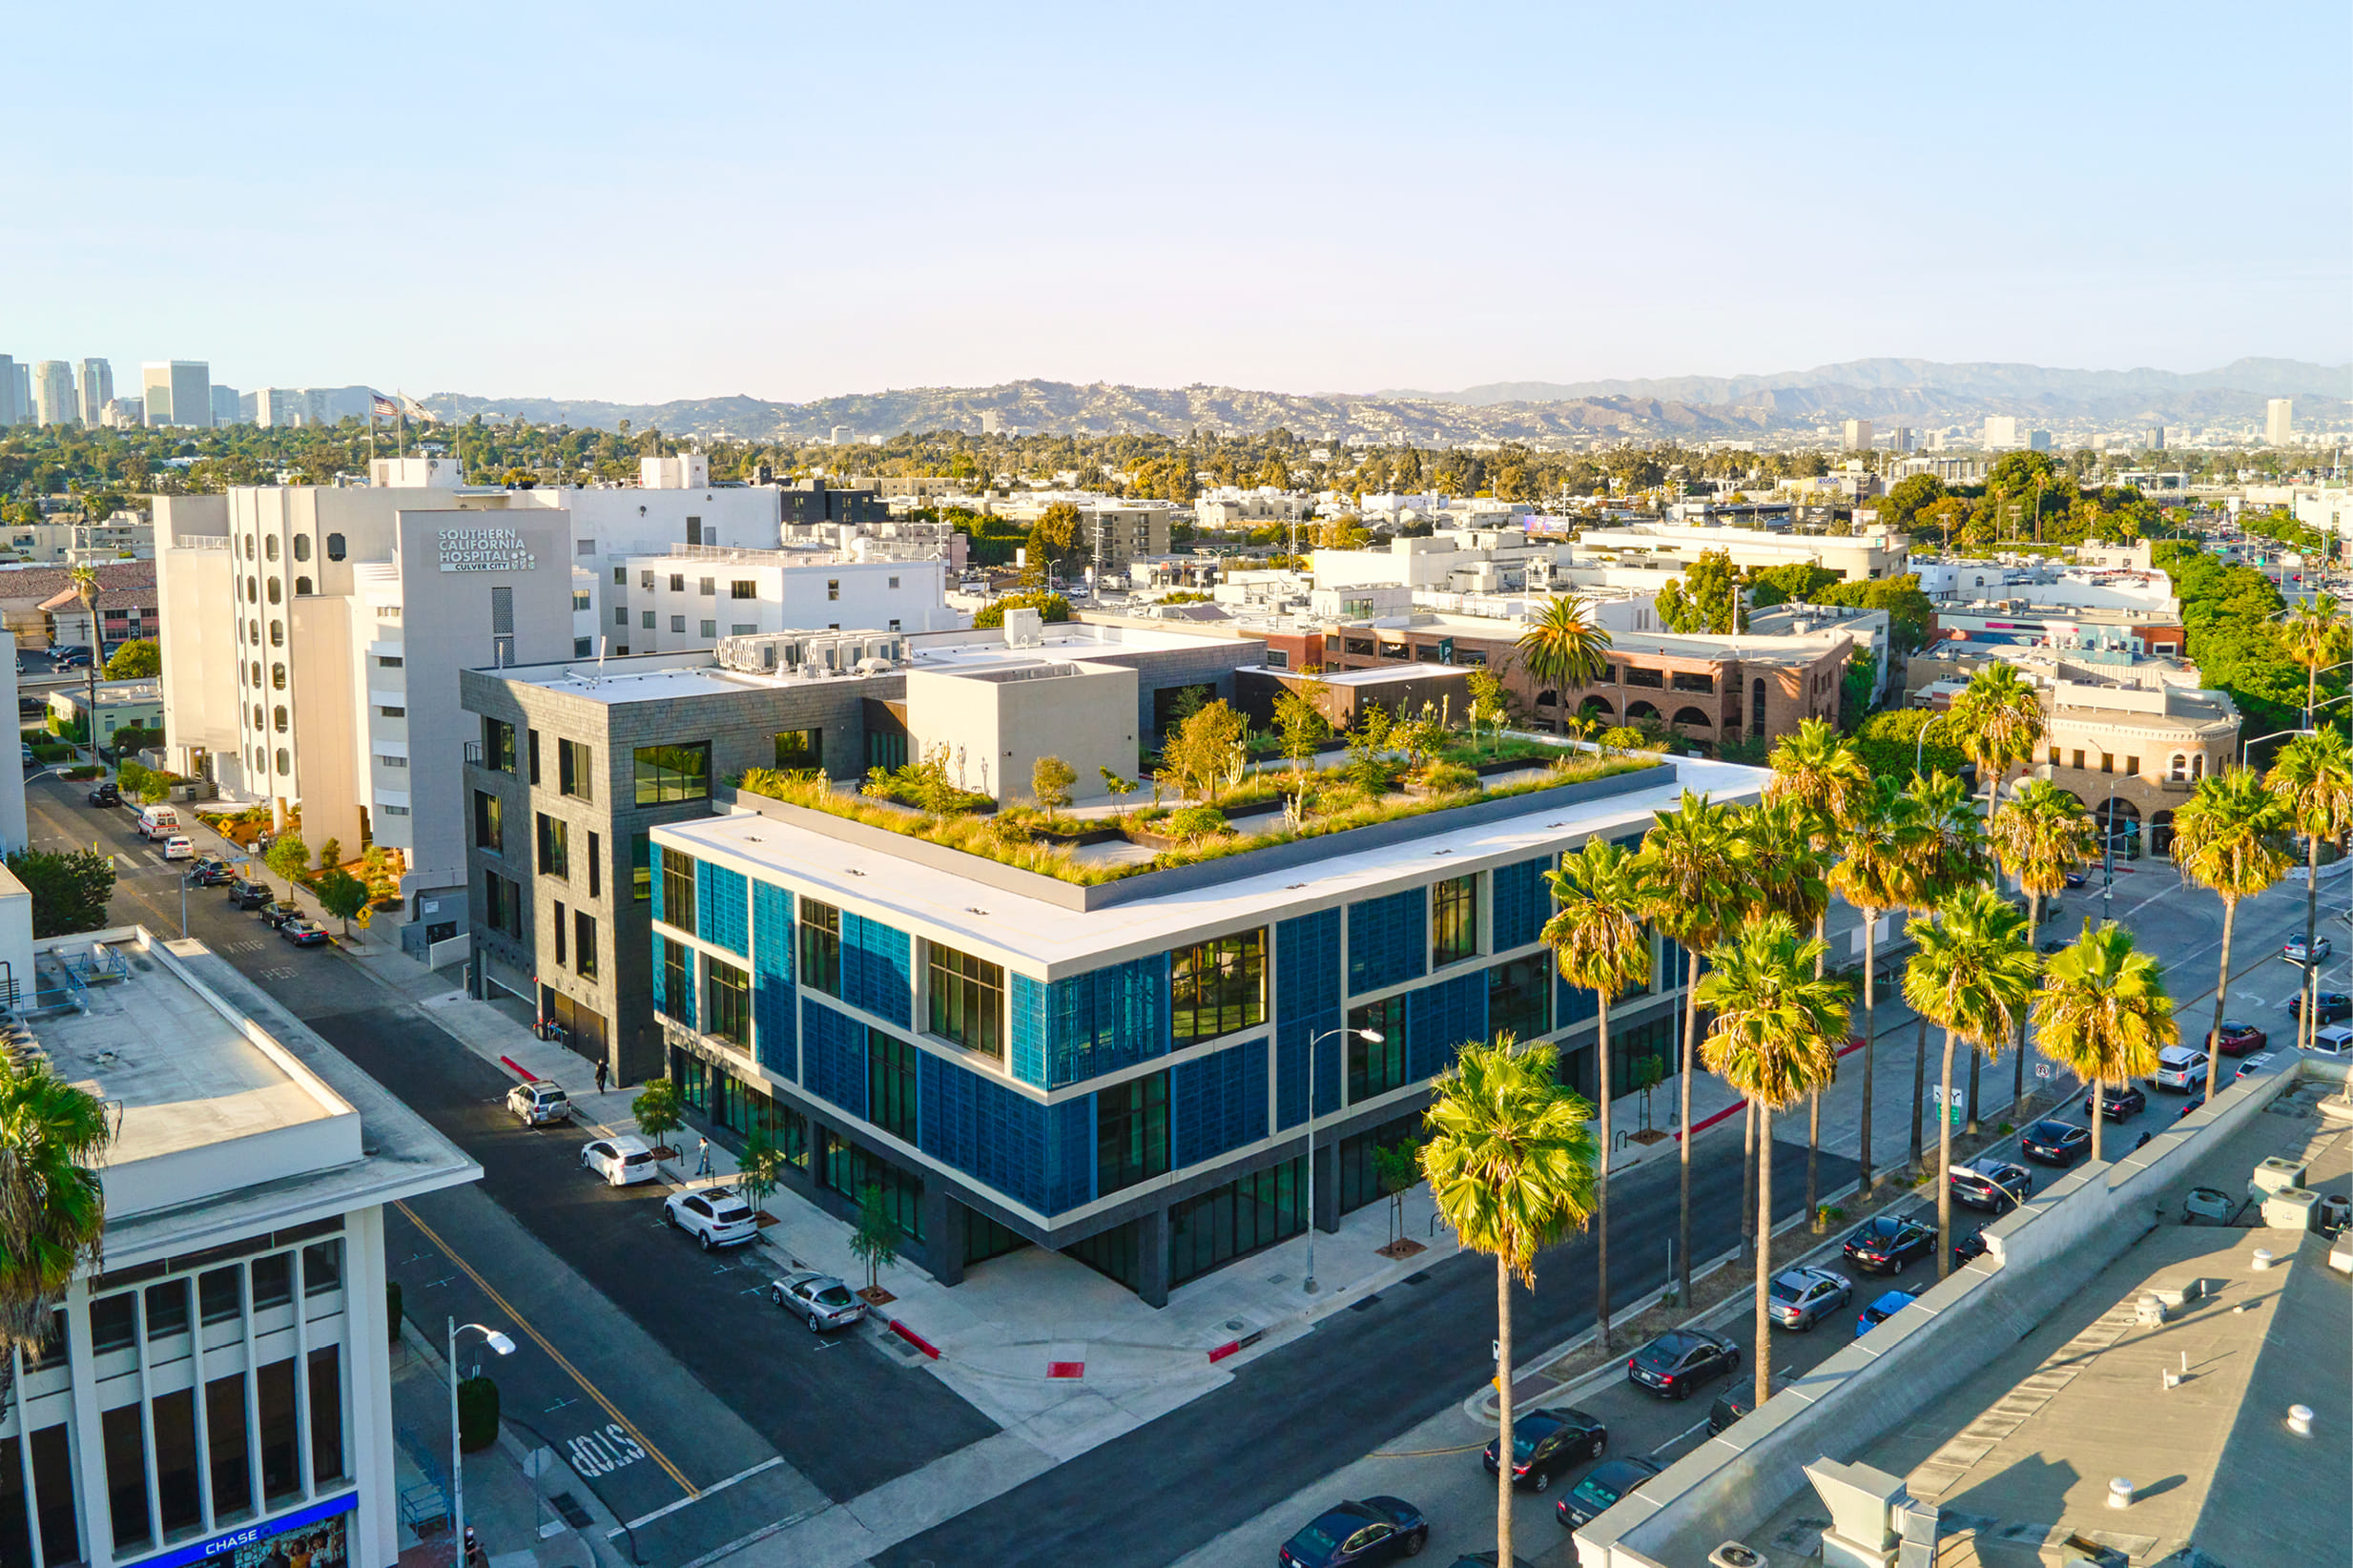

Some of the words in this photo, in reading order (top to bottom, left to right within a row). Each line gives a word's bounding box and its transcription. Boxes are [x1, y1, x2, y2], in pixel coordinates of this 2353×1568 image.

[438, 528, 515, 540] SOUTHERN
[439, 539, 525, 550] CALIFORNIA
[439, 550, 508, 563] HOSPITAL
[222, 939, 265, 954] XING
[259, 966, 298, 980] PED
[567, 1423, 646, 1477] STOP
[205, 1529, 258, 1556] CHASE
